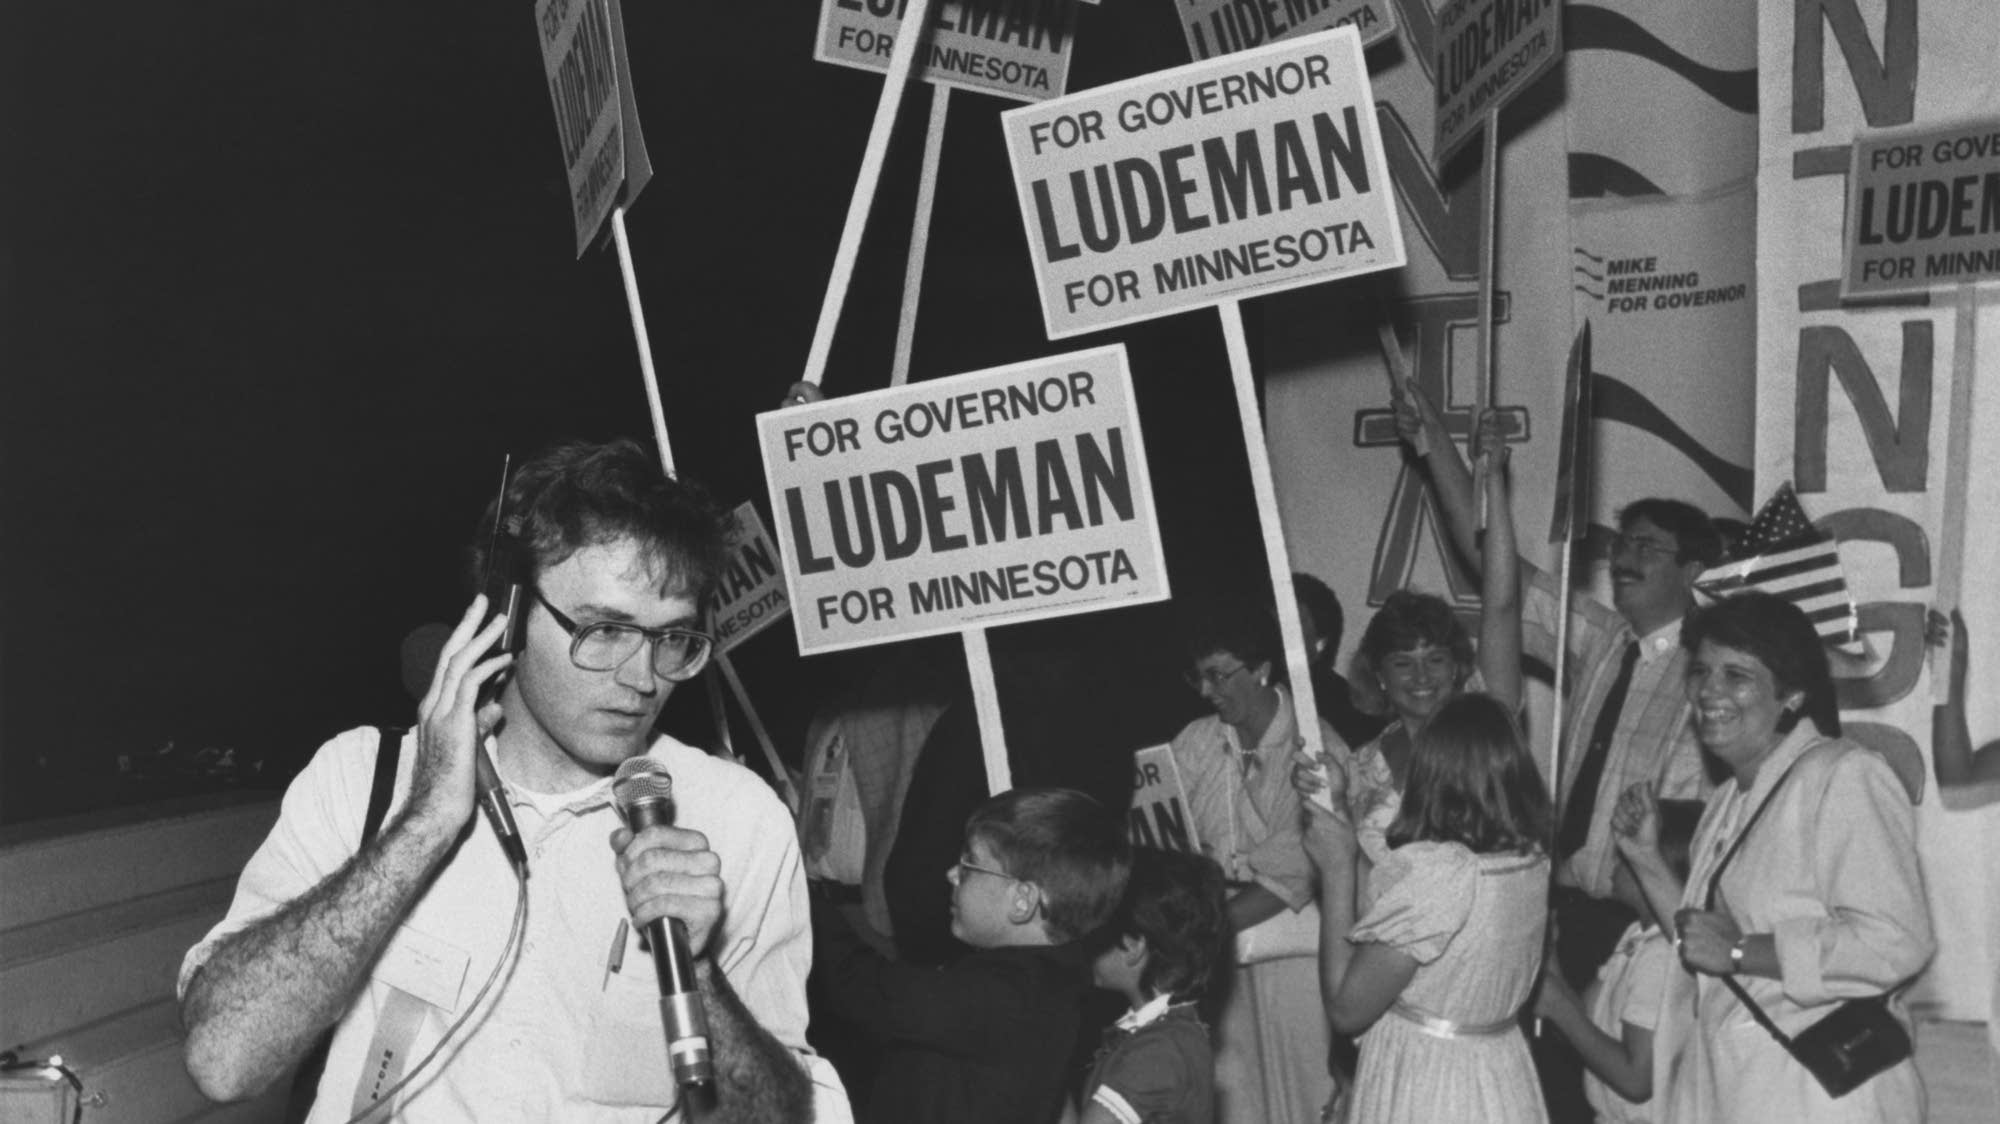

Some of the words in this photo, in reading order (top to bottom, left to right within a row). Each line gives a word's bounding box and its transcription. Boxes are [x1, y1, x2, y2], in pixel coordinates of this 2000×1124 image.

[838, 26, 894, 58] FOR
[917, 43, 1050, 91] INNESOTA
[1468, 29, 1547, 115] MINNESOTA
[1030, 110, 1105, 155] FOR
[1118, 55, 1330, 133] GOVERNOR
[1031, 105, 1371, 264] LUDEMAN
[1872, 144, 1923, 171] FOR
[1065, 269, 1140, 313] FOR
[1153, 220, 1375, 295] MINNESOTA
[1607, 256, 1657, 276] MIKE
[1607, 271, 1699, 294] MENNING
[1608, 296, 1648, 314] FOR
[1654, 283, 1746, 310] GOVERNOR
[1863, 257, 1915, 282] FOR
[783, 418, 862, 462] FOR
[874, 371, 1096, 445] GOVERNOR
[784, 426, 1136, 576] LUDEMAN
[817, 587, 896, 629] FOR
[909, 548, 1138, 615] MINNESOTA
